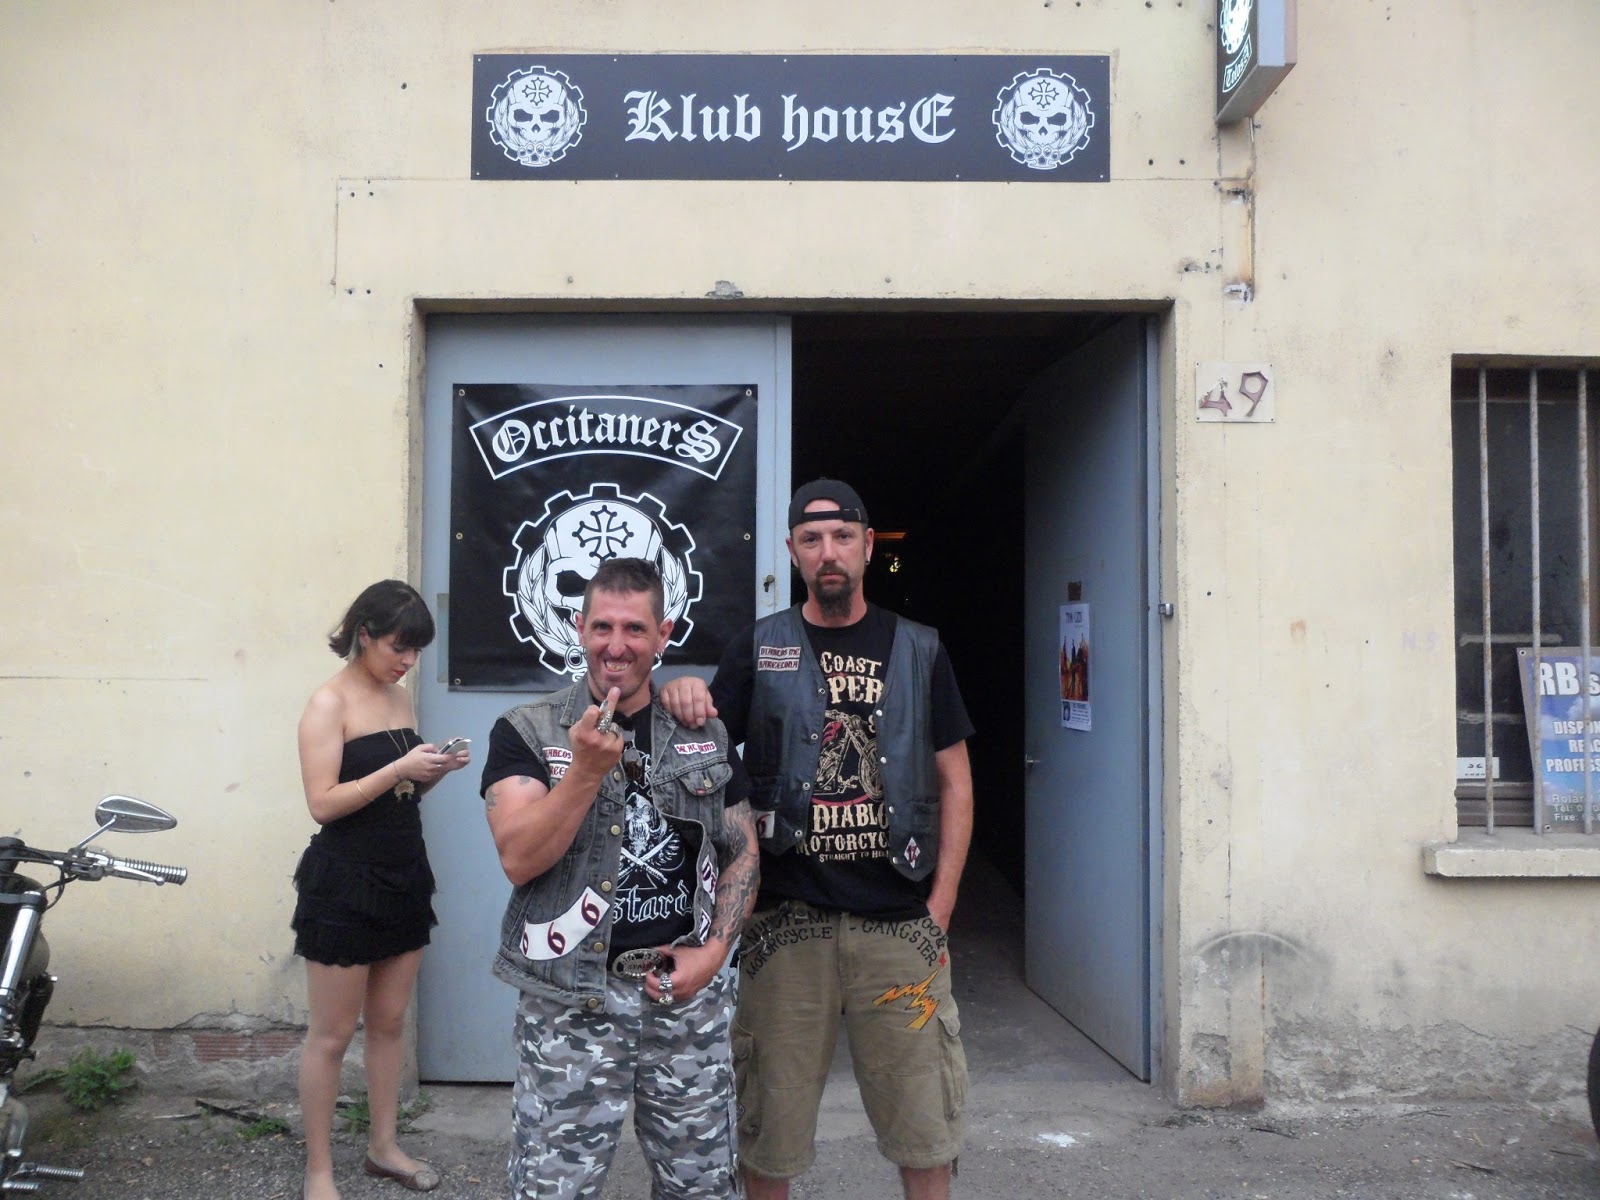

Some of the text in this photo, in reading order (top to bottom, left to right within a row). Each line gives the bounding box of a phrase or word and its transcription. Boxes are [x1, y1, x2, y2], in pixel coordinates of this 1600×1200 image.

[624, 90, 956, 152] Klub housE
[492, 405, 722, 463] OccitanerS
[821, 651, 882, 677] COAST
[861, 919, 938, 967] GANGSTER
